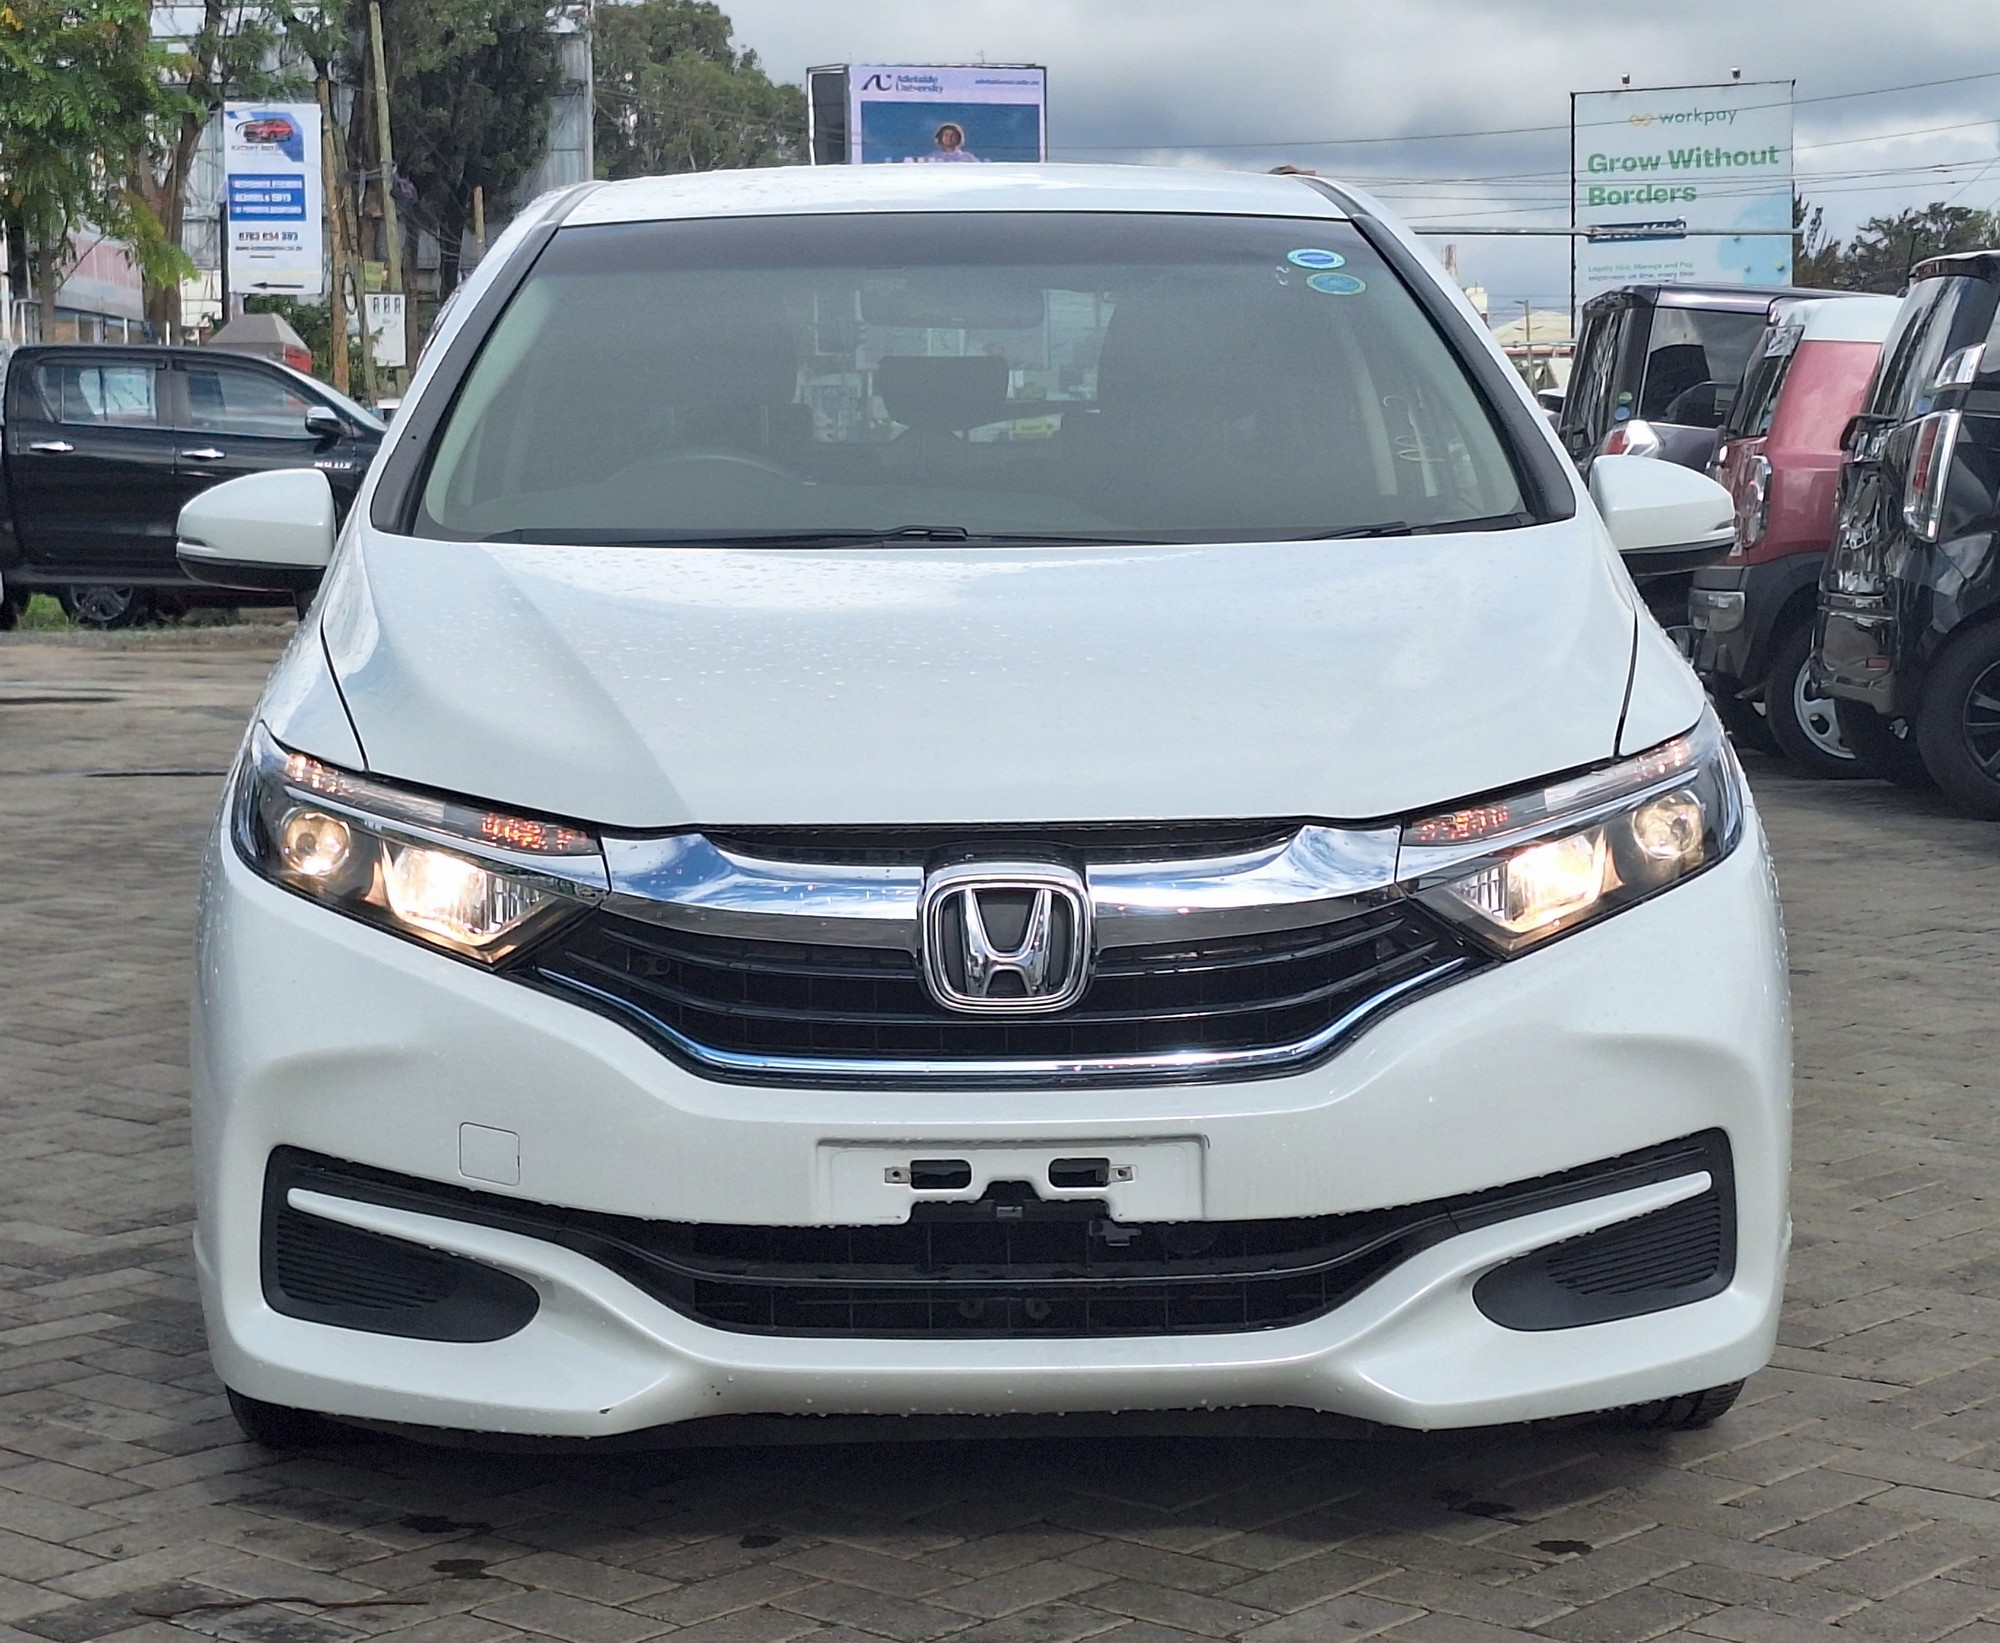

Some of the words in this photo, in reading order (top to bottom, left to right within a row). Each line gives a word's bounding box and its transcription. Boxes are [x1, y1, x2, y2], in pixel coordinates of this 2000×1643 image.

[1658, 107, 1738, 126] workpay
[1587, 153, 1661, 174] Grow
[1667, 146, 1780, 170] Without
[1588, 184, 1698, 207] Borders
